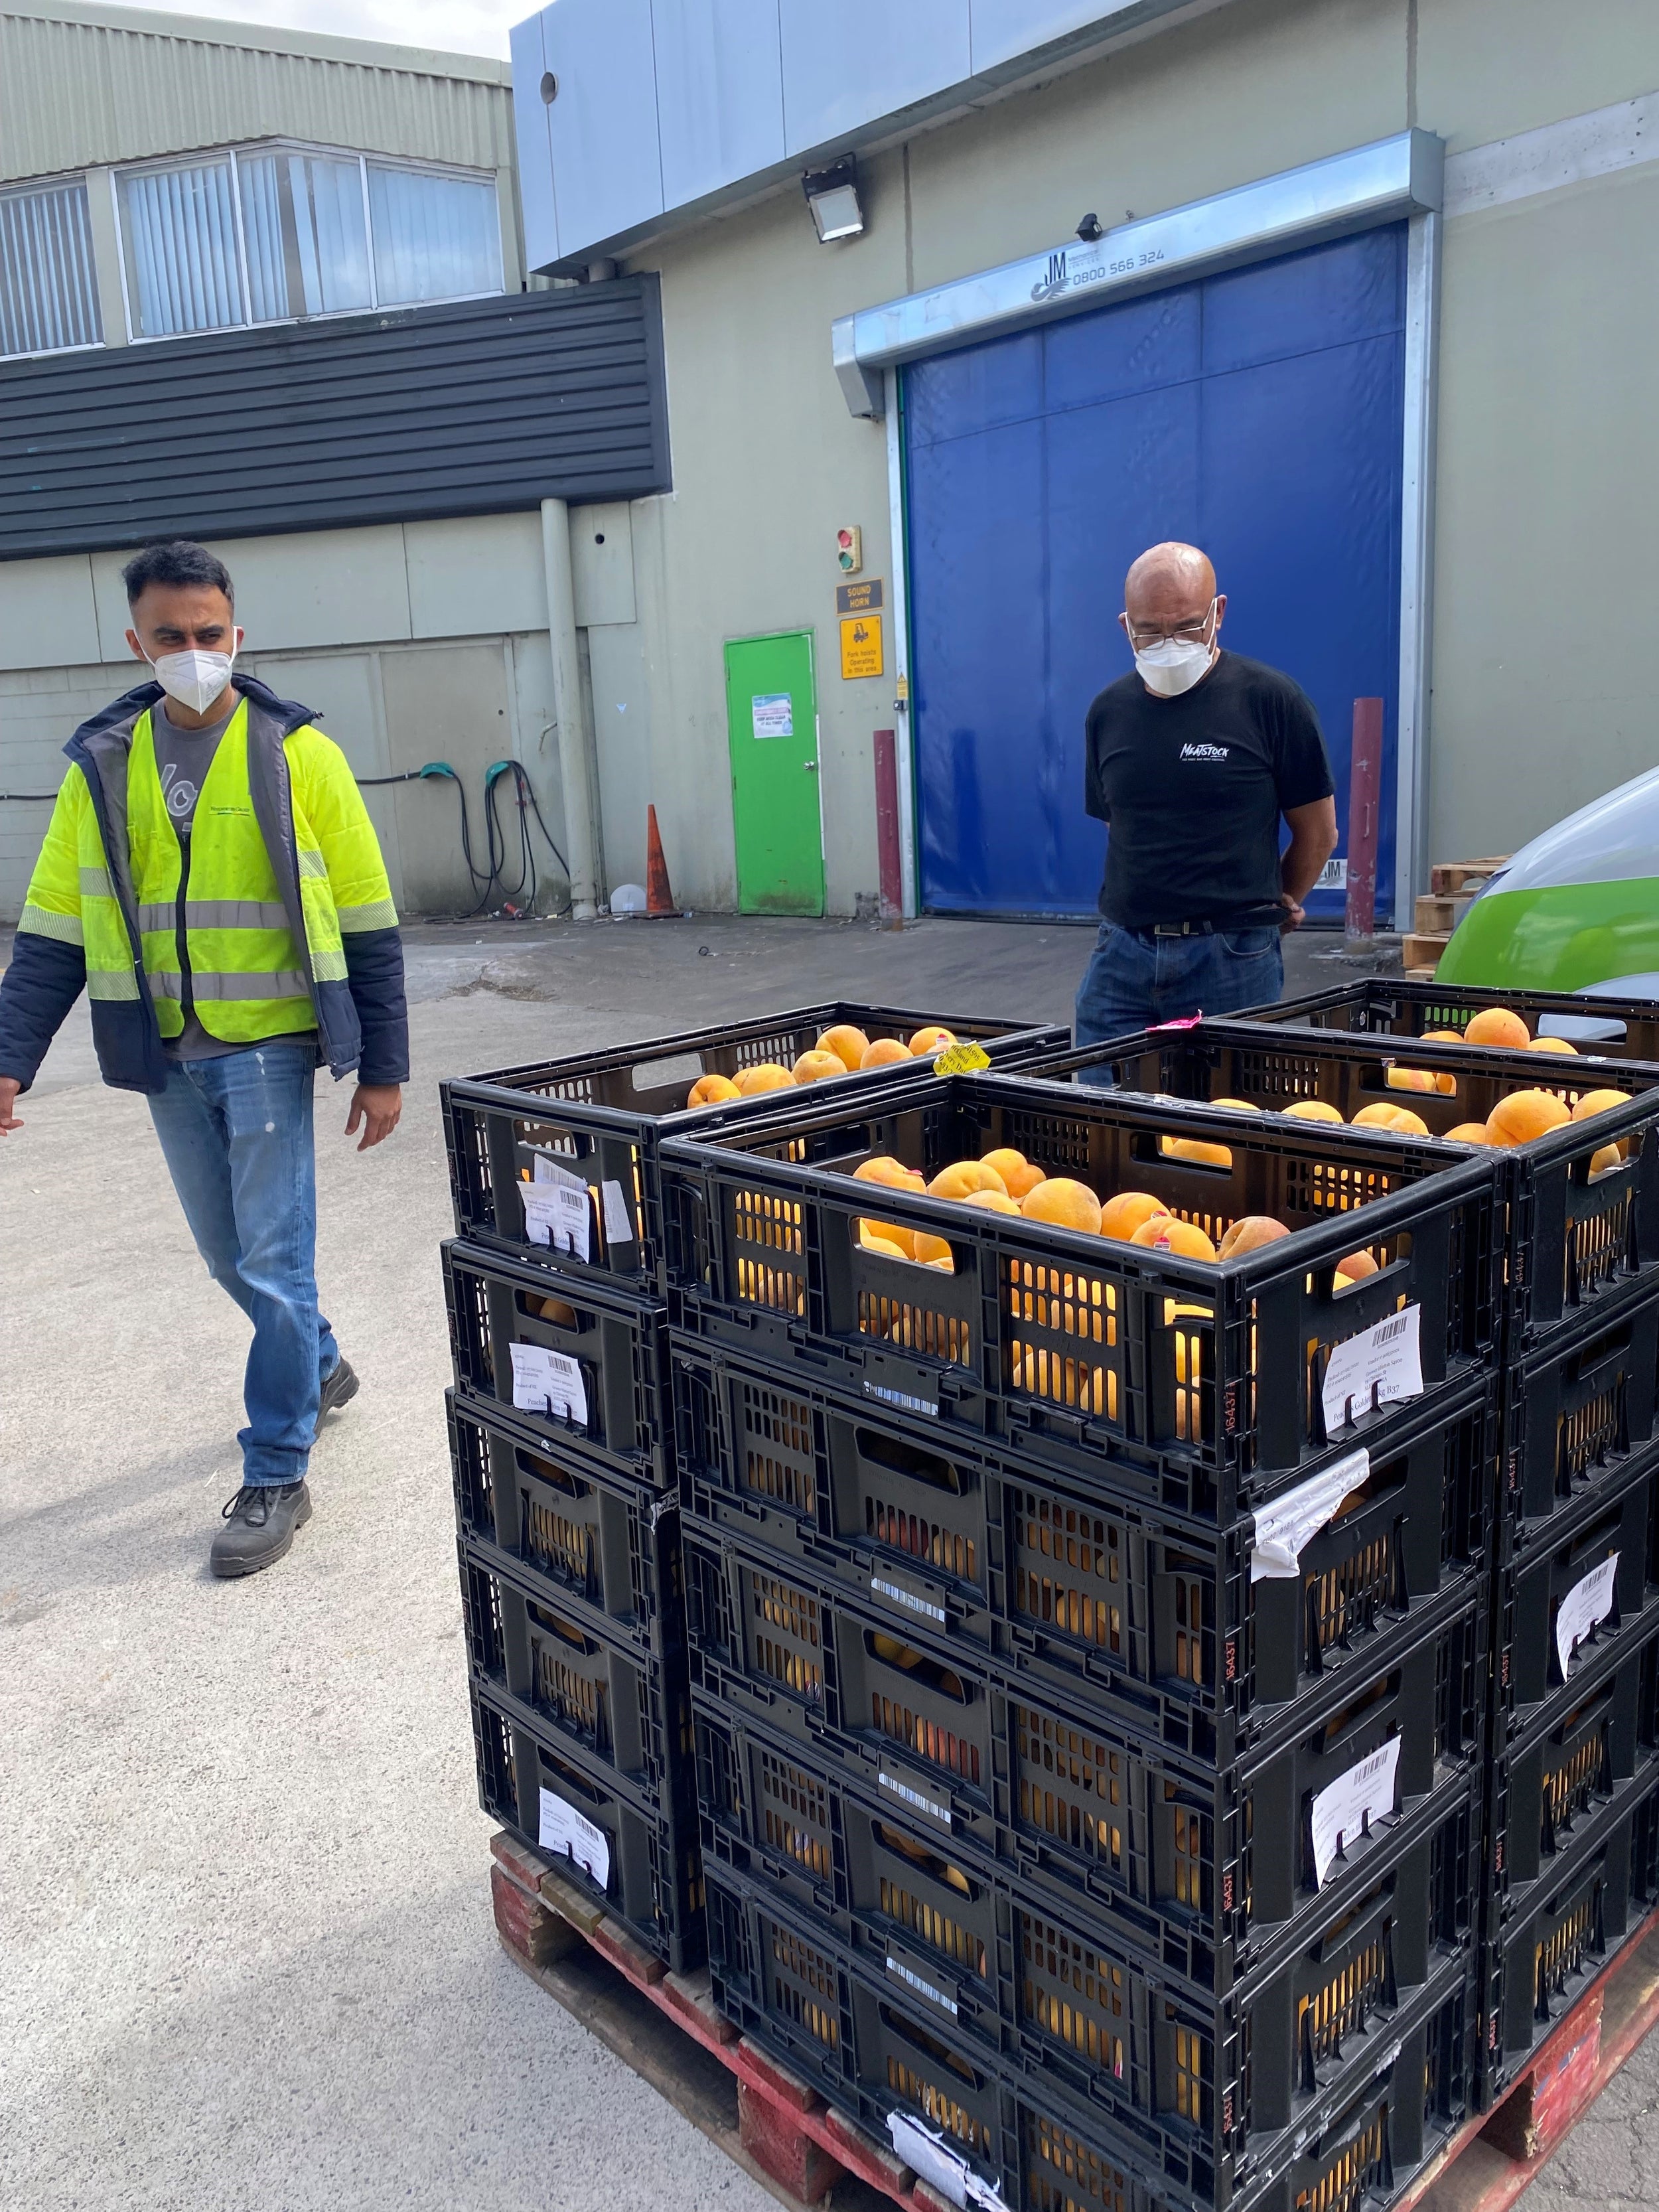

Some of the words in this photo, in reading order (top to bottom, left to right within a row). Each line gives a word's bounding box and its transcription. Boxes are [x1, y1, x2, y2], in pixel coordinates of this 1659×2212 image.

[1045, 252, 1066, 287] JM
[1073, 267, 1106, 286] 0800
[1110, 258, 1135, 275] 566
[1139, 249, 1165, 266] 324
[847, 585, 871, 597] SOUND
[849, 597, 870, 609] HORN
[1325, 861, 1340, 879] JM
